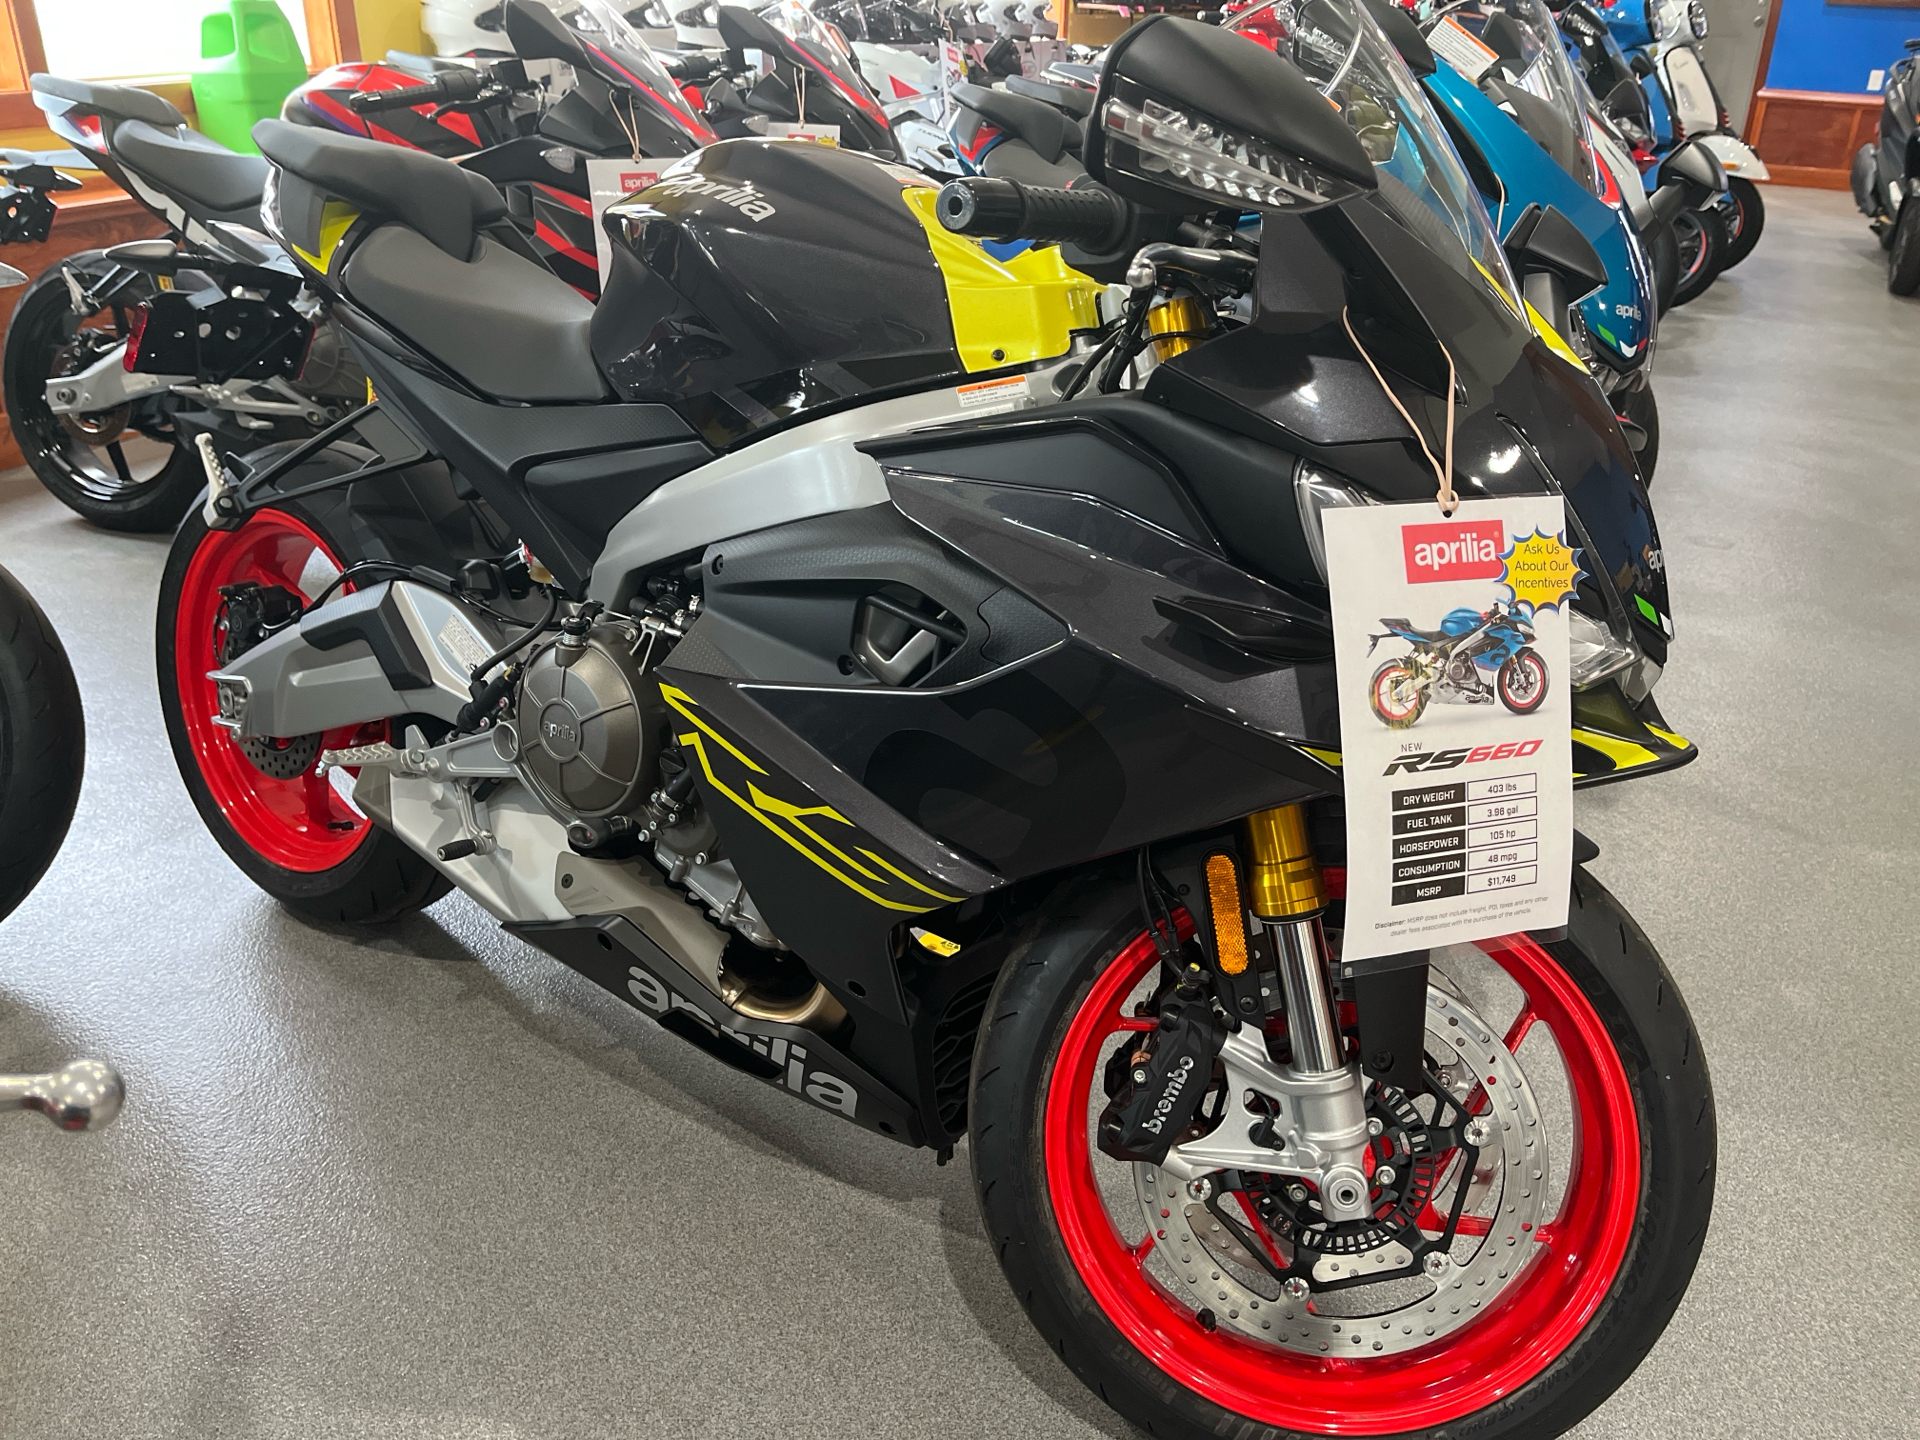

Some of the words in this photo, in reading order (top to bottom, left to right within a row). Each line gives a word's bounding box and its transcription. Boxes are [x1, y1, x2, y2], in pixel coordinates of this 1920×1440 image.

[663, 177, 776, 223] aprilia
[1414, 532, 1496, 571] aprilia
[1523, 543, 1543, 555] Ask
[1546, 543, 1560, 555] Us
[1514, 560, 1547, 572] About
[1549, 560, 1569, 571] Our
[1515, 576, 1569, 588] Incentives
[543, 720, 577, 743] aprilia
[1401, 742, 1423, 753] NEW
[1382, 739, 1544, 776] RS660
[1487, 784, 1504, 793] 403
[1505, 782, 1517, 792] lbs
[1403, 794, 1421, 806] DRY
[1422, 790, 1455, 804] WEIGHT
[1506, 806, 1518, 817] gal
[1406, 818, 1429, 829] FUEL
[1430, 814, 1453, 826] TANK
[1490, 830, 1504, 840] 105
[1505, 829, 1516, 841] hp
[1399, 837, 1459, 854] HORSEPOWER
[1488, 854, 1499, 863] 48
[1500, 852, 1518, 864] mpg
[1398, 860, 1461, 877] CONSUMPTION
[1487, 874, 1516, 887] $11,749
[1416, 886, 1442, 898] MSRP
[1374, 918, 1405, 929] Disclaimer:
[1406, 915, 1424, 924] MSRP
[1424, 913, 1437, 921] does
[1448, 908, 1467, 917] include
[1420, 921, 1450, 931] associated
[1472, 913, 1497, 924] purchase
[1141, 1055, 1194, 1135] brembo
